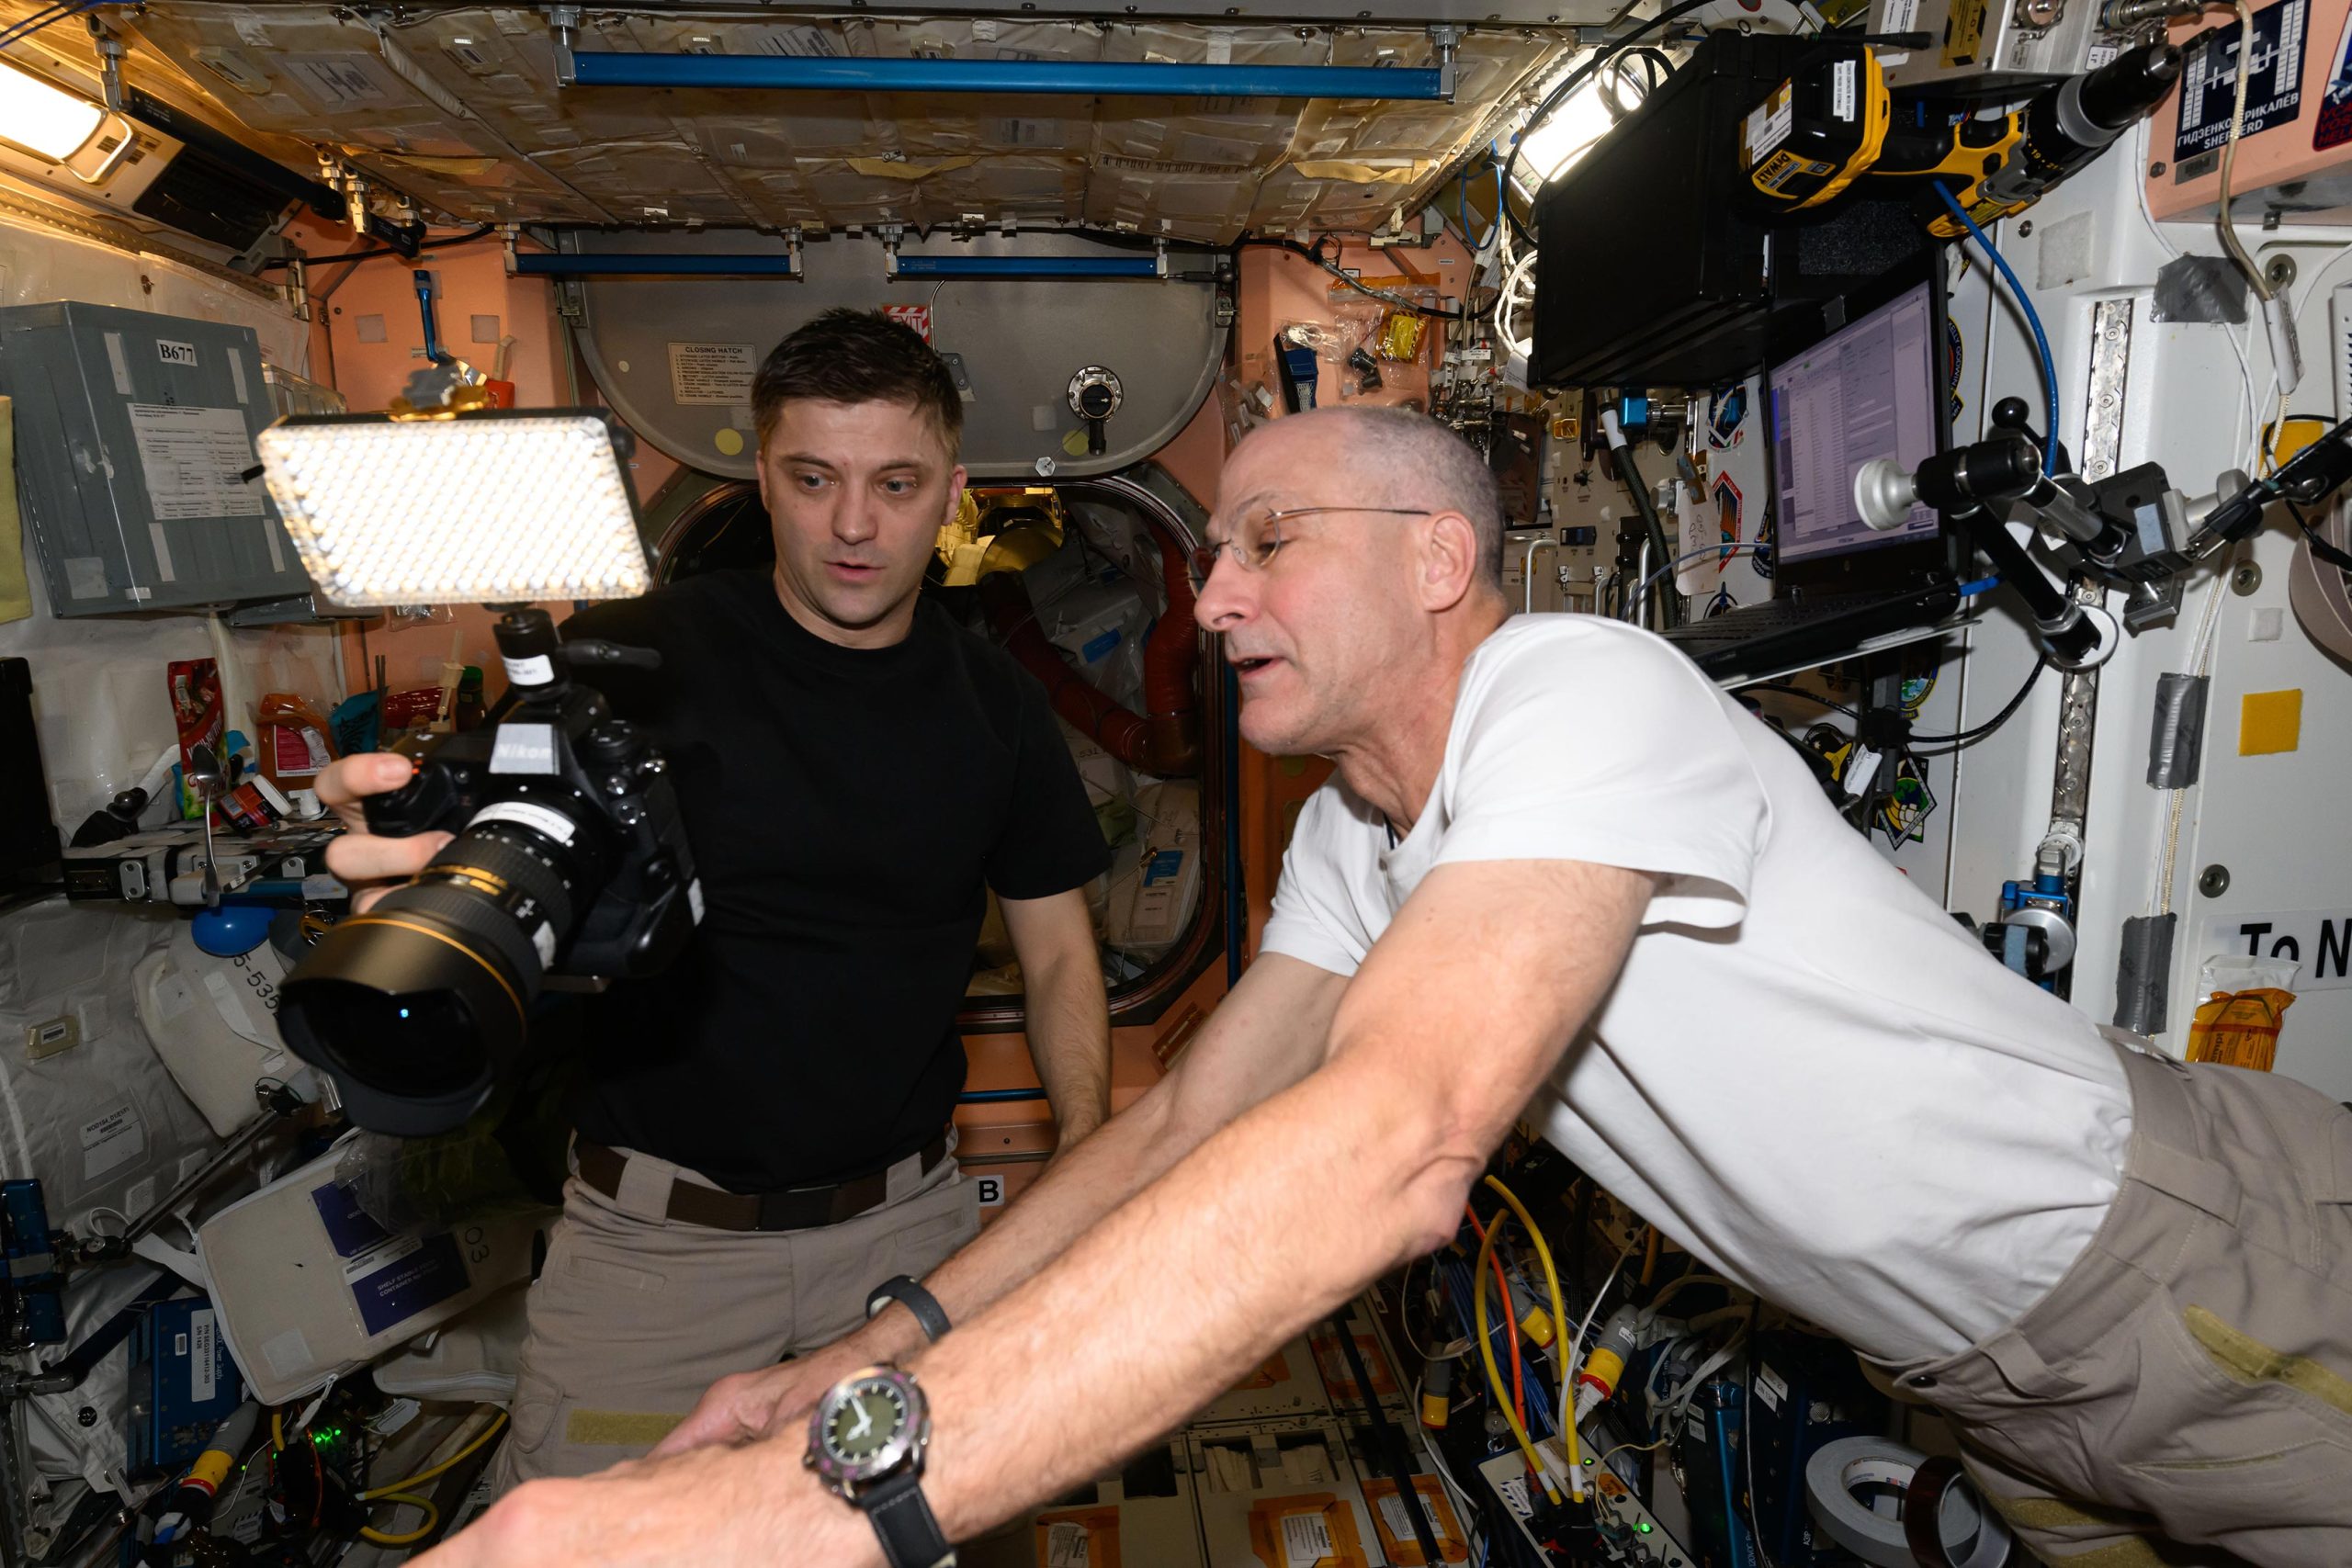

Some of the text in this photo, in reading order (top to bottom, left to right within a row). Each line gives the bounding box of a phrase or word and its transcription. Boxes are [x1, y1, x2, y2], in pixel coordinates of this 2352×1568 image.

[2177, 93, 2298, 147] ГИДЗЕНКО РИКАЛЁВ
[2204, 119, 2263, 149] SHEPERD
[160, 344, 195, 363] B677
[498, 743, 551, 759] Nikon
[978, 1179, 1000, 1202] B
[377, 1278, 396, 1292] SHELF
[215, 1364, 224, 1380] Supply
